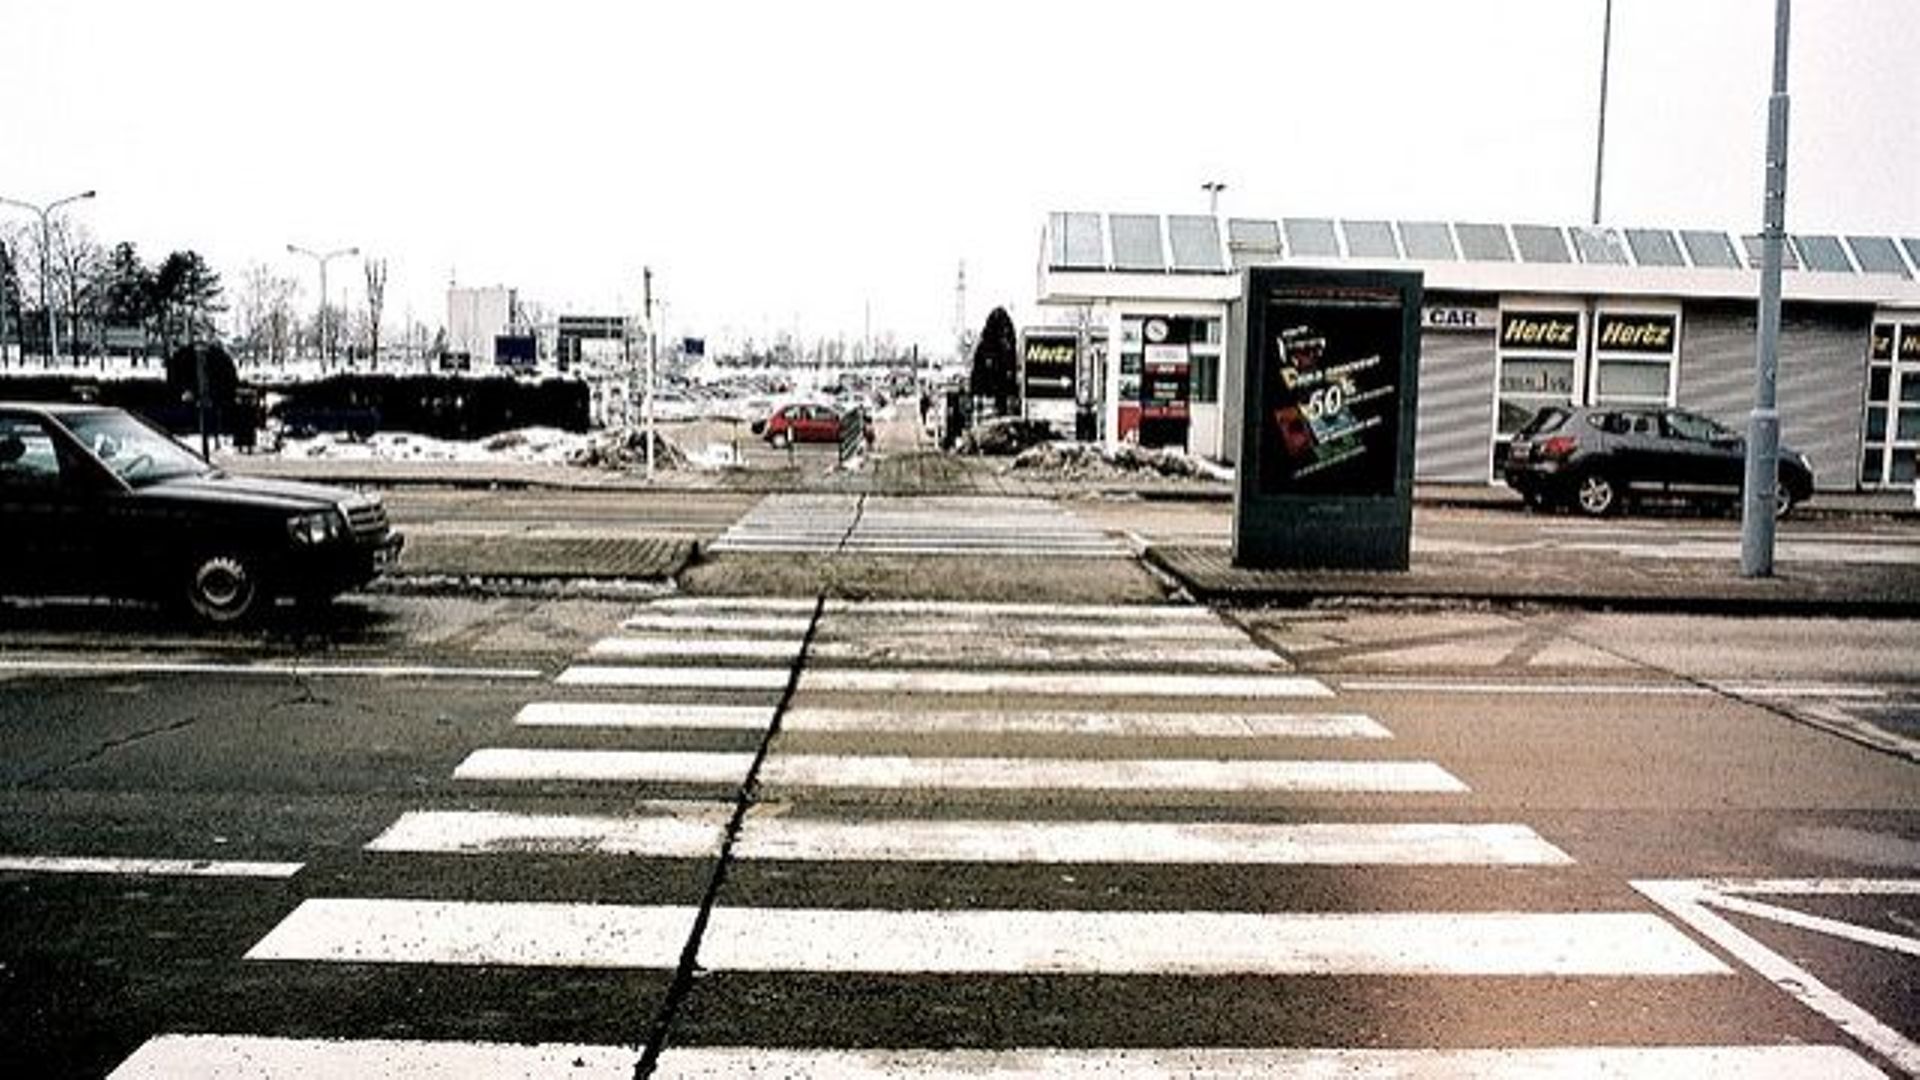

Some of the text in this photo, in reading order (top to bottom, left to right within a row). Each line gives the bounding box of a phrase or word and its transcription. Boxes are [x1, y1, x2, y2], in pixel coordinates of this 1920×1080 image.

[1429, 308, 1477, 325] CAR
[1504, 318, 1574, 343] Hertz
[1601, 321, 1671, 345] Hertz
[1027, 343, 1074, 362] Hertz
